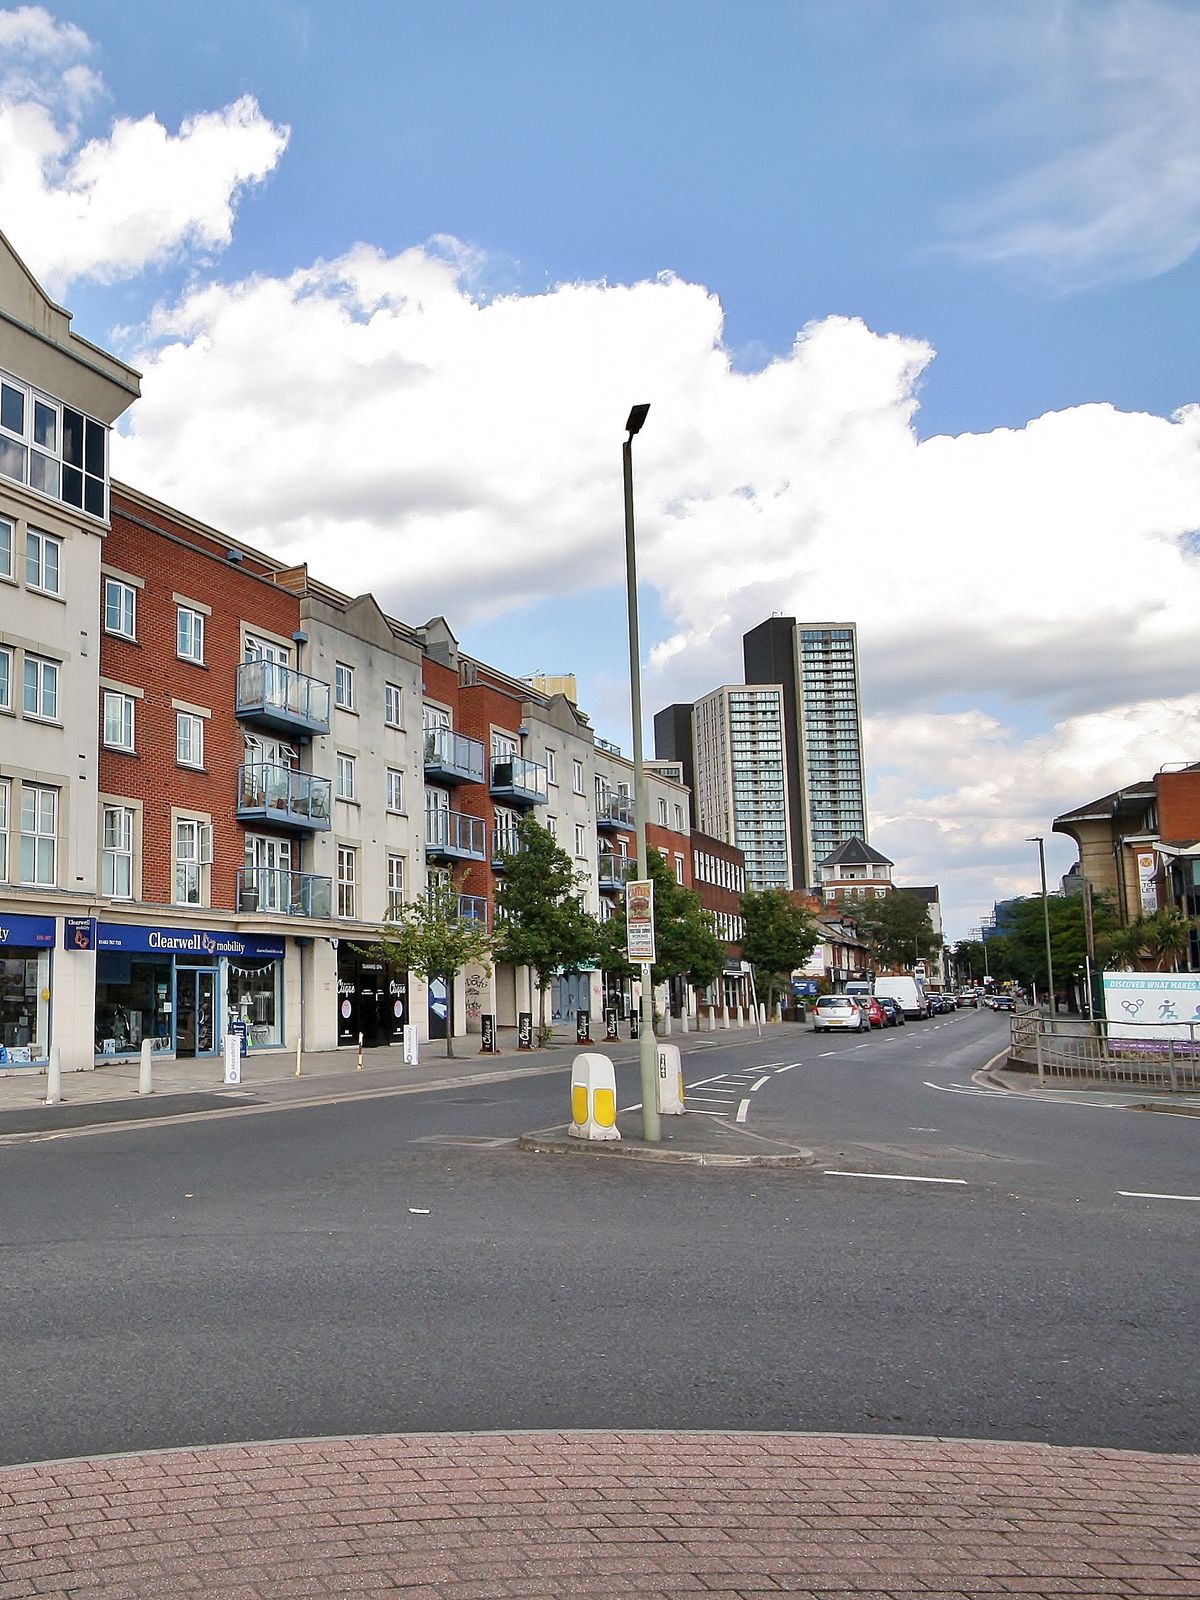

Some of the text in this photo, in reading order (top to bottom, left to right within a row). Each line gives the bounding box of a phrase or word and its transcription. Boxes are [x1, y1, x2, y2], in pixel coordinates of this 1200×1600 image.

[149, 932, 246, 954] Clearwell mobility
[337, 979, 355, 997] Clique
[389, 979, 406, 997] Clique
[482, 1020, 492, 1044] Clique
[519, 1018, 532, 1041] Clique
[577, 1014, 589, 1036] Clique
[608, 1013, 617, 1033] Clique
